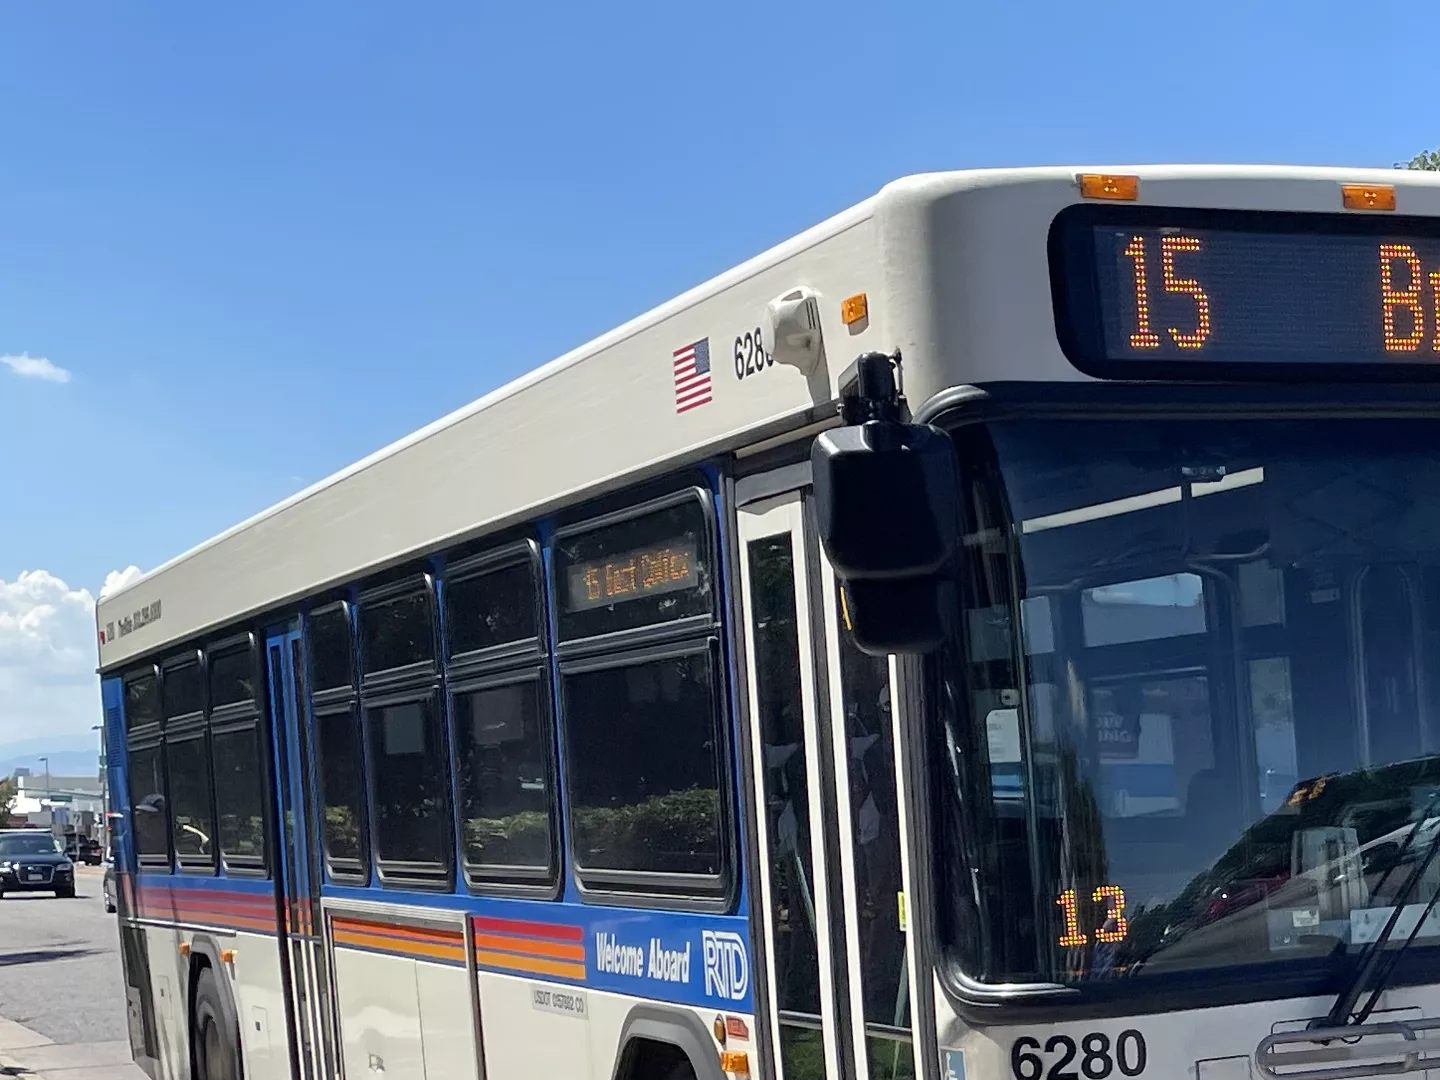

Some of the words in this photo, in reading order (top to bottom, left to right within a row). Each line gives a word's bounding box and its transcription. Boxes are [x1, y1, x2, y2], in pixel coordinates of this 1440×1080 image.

[1123, 236, 1210, 349] 15
[1056, 885, 1127, 946] 13
[595, 932, 644, 978] Welcome
[647, 937, 691, 984] Aboard
[702, 930, 749, 1000] RTD
